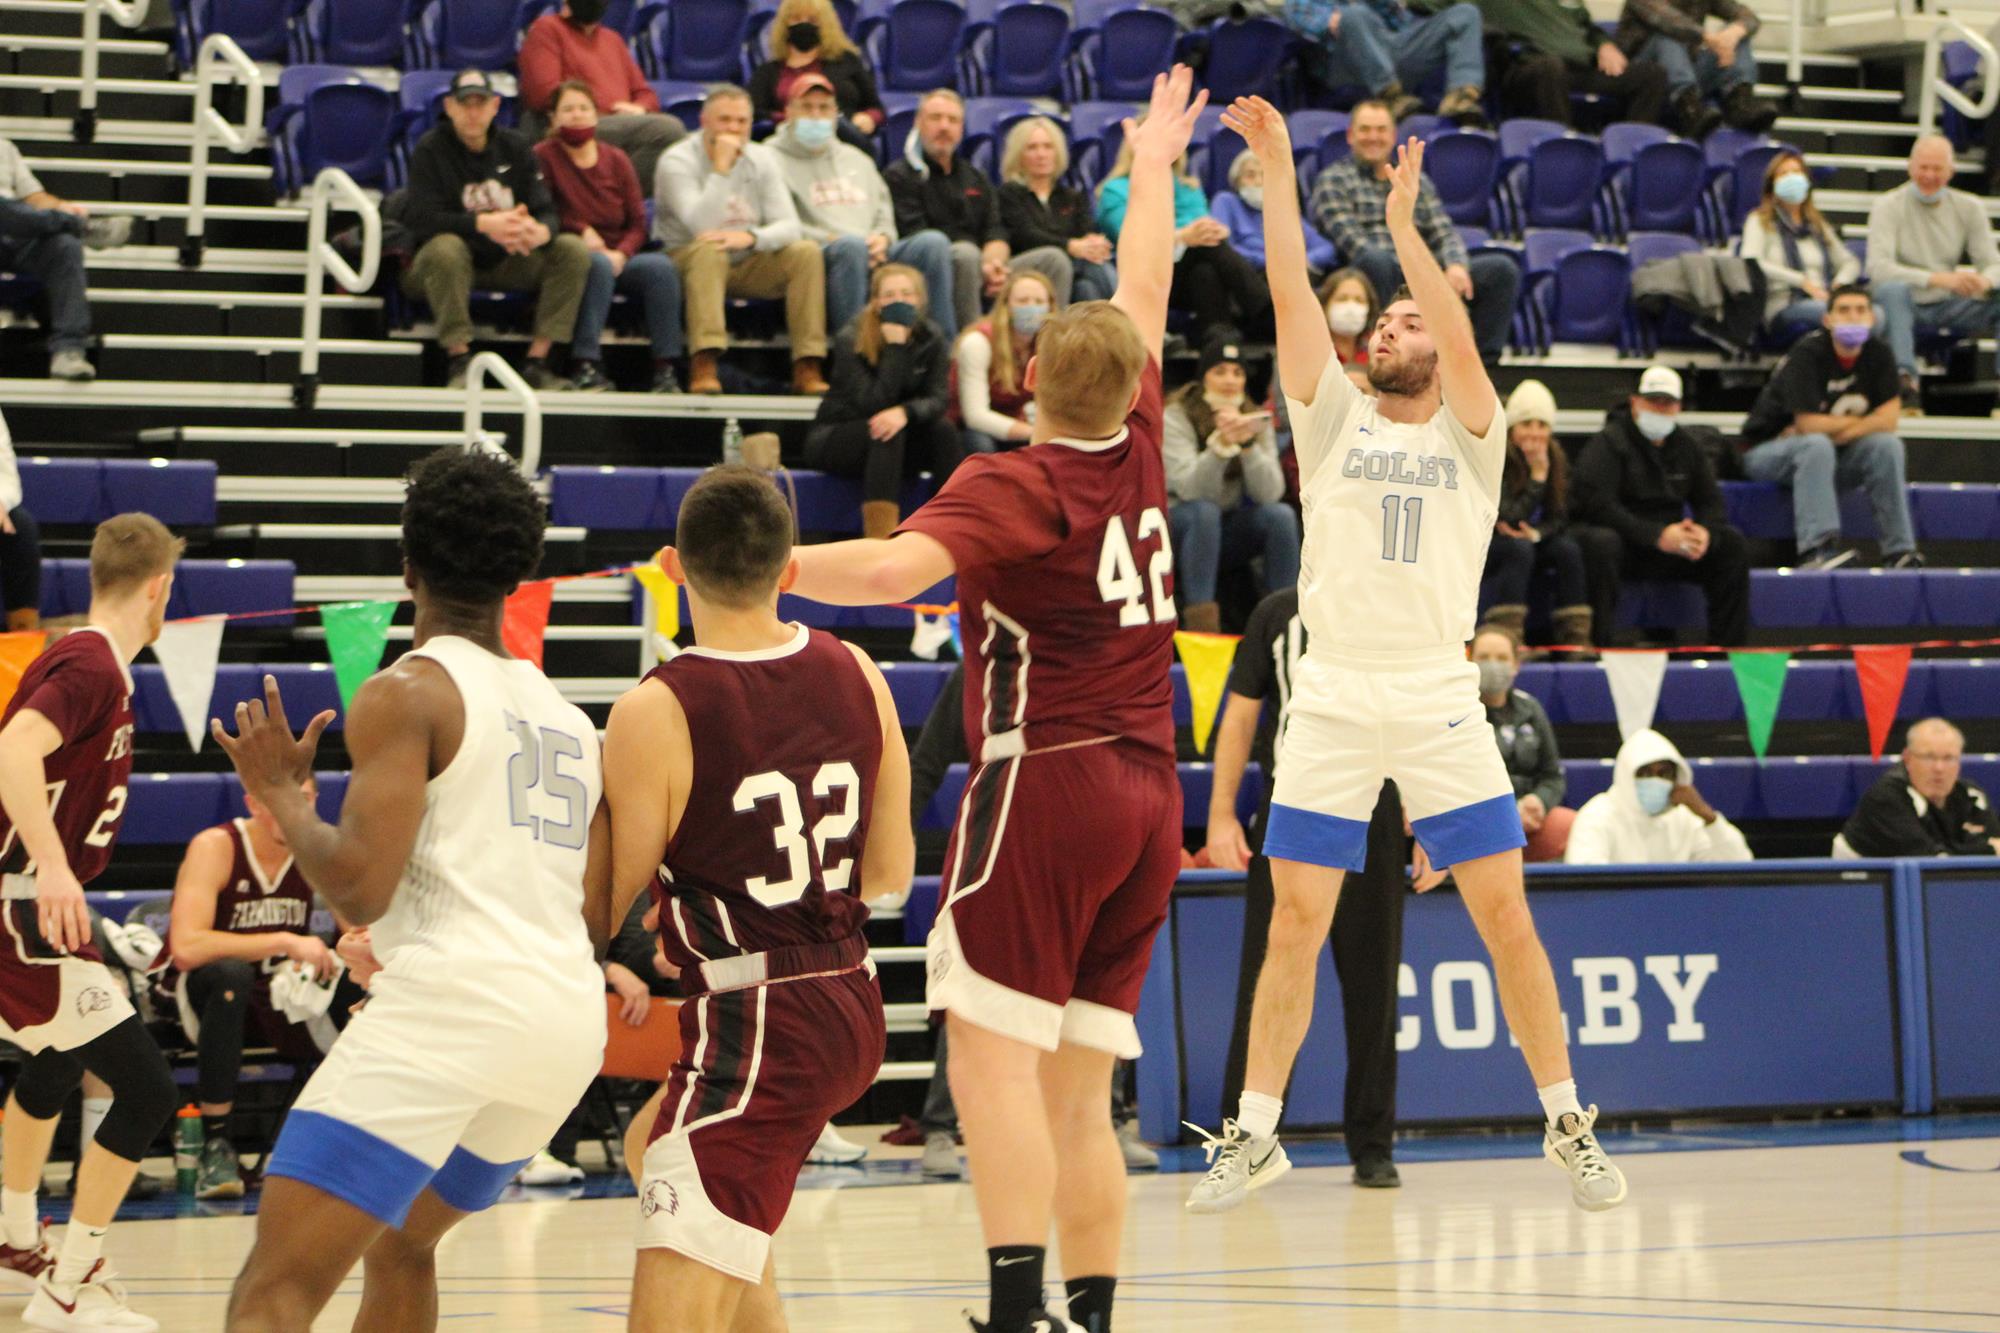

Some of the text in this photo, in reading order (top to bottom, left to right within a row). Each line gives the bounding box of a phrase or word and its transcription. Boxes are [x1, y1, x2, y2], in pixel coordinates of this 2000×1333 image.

[1342, 448, 1459, 490] COLBY
[1096, 507, 1178, 627] 42
[1382, 494, 1423, 563] 11
[732, 762, 860, 908] 32
[1395, 954, 1718, 1051] OBY
